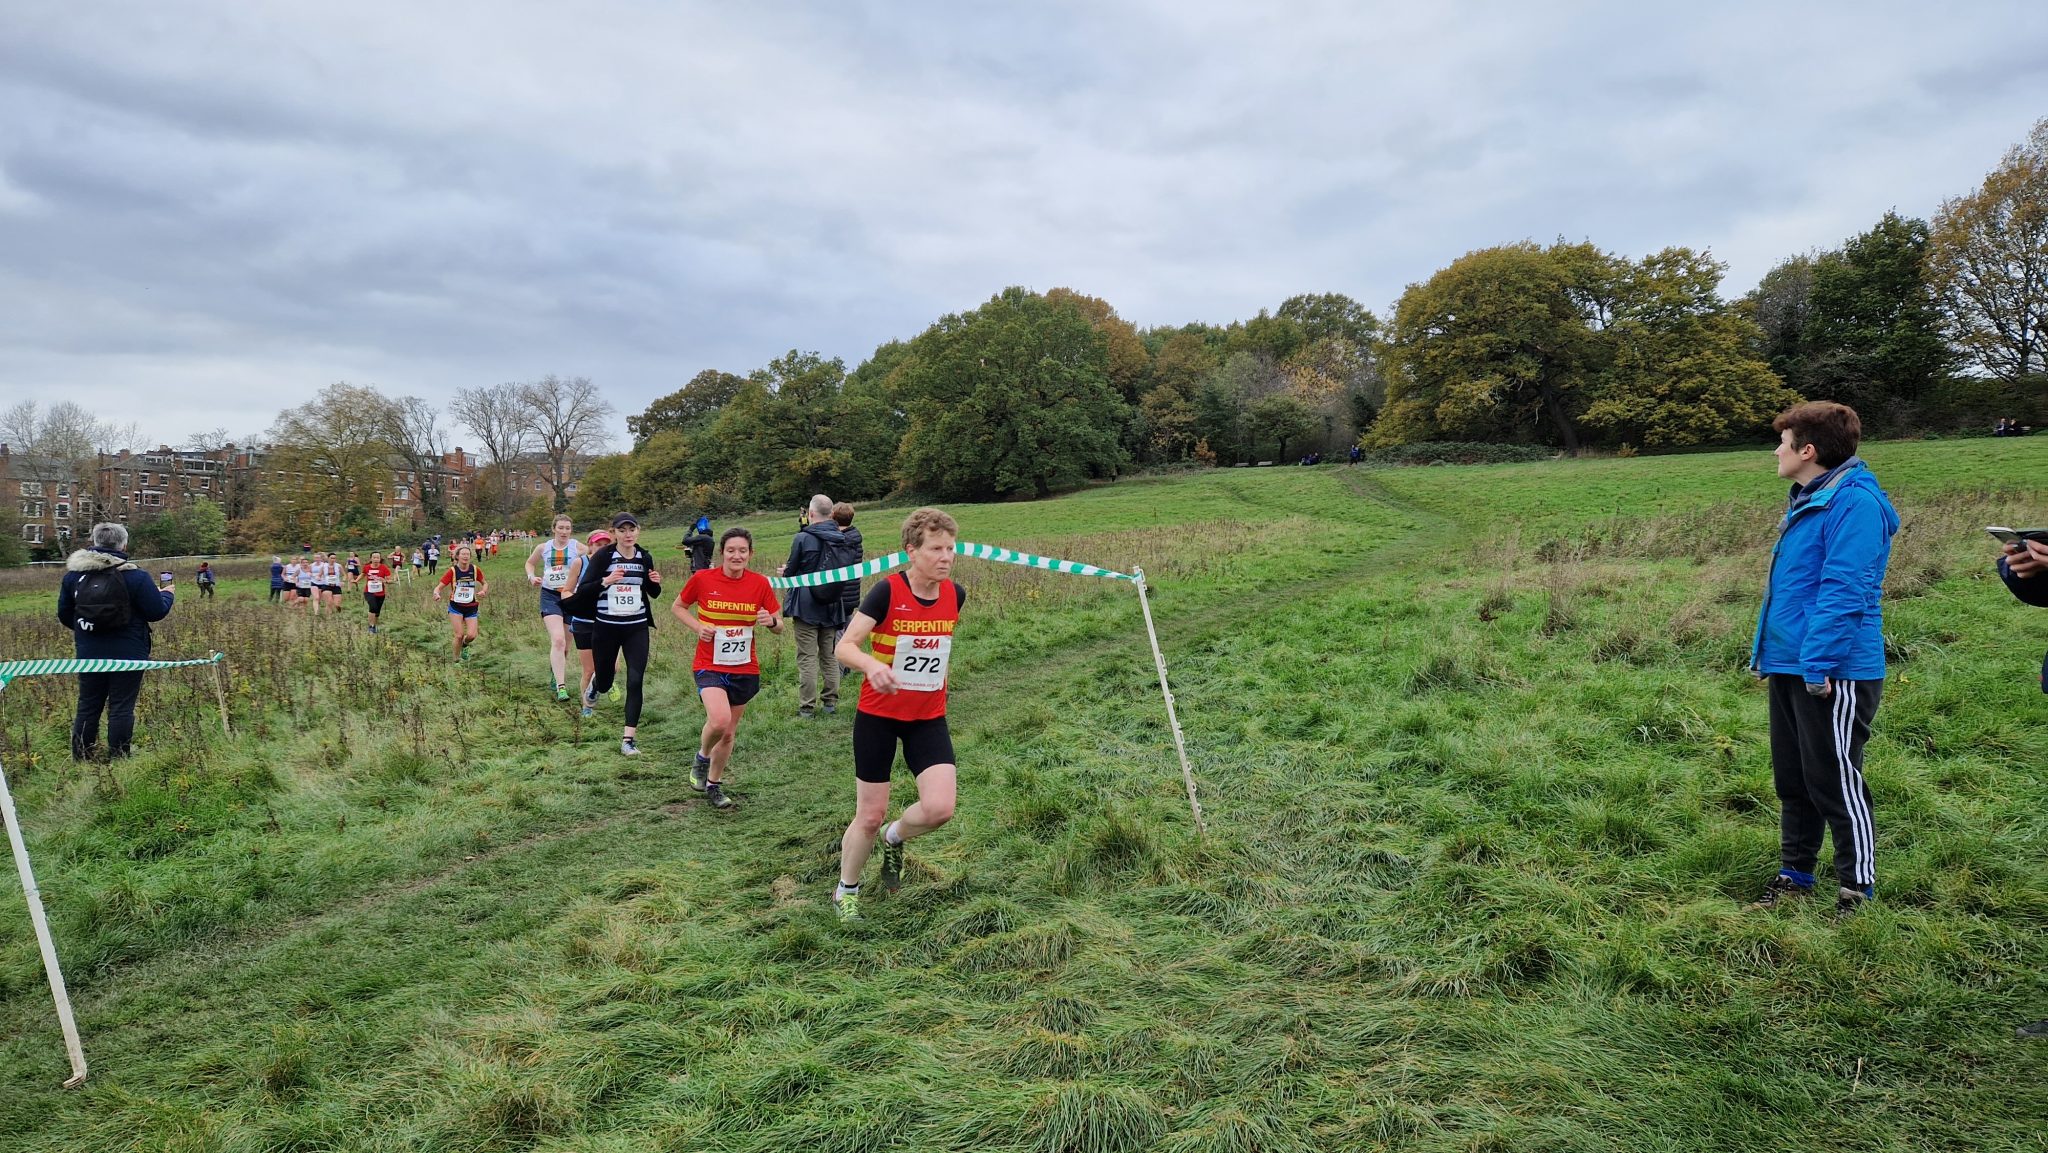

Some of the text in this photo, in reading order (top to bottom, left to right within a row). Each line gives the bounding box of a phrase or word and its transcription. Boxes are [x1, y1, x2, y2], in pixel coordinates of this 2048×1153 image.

[549, 573, 566, 581] 235
[614, 596, 634, 605] 138
[707, 599, 757, 612] SERPENTINE
[892, 619, 955, 633] SERPENTINE
[725, 628, 744, 638] SEAA
[721, 640, 746, 653] 273
[911, 638, 940, 650] SEAA
[903, 656, 941, 673] 272
